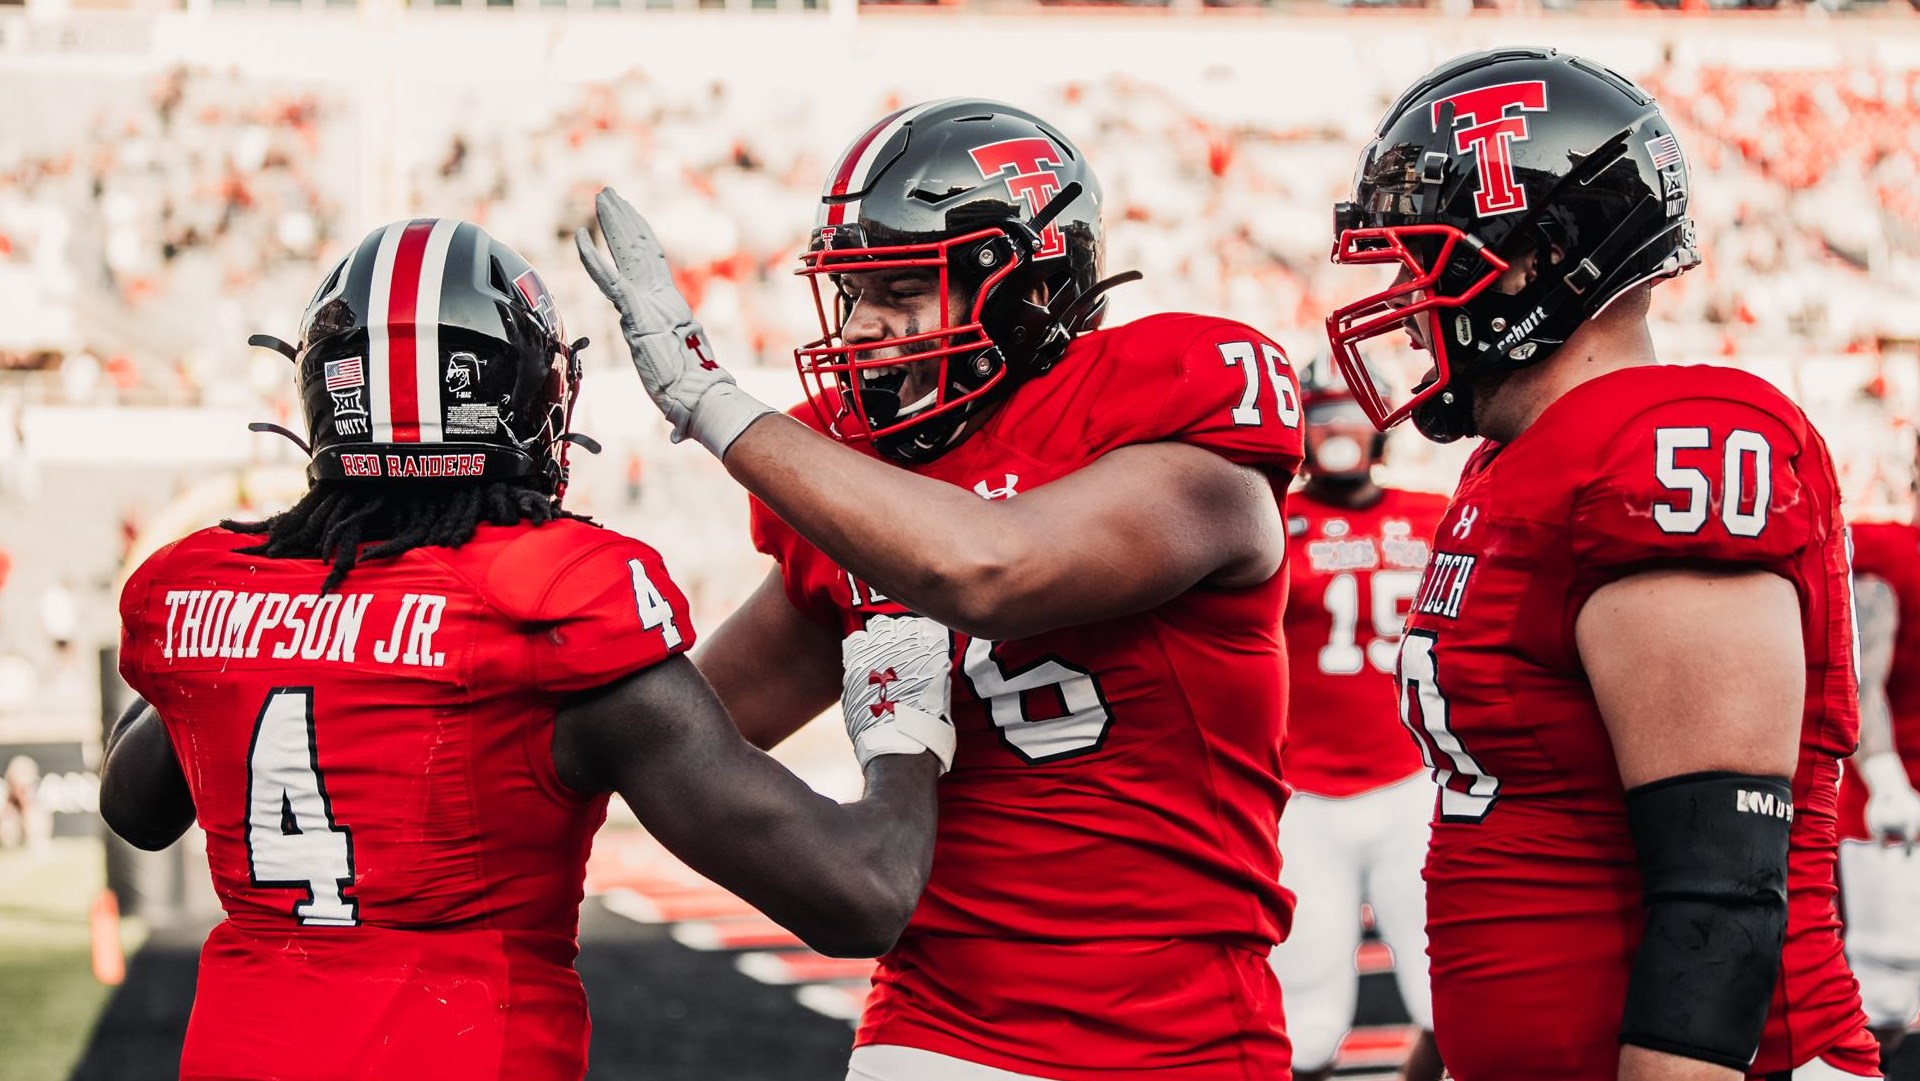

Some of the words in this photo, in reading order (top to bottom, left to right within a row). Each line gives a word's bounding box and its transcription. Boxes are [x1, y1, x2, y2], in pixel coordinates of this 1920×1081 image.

[335, 417, 369, 436] UNITY
[1217, 341, 1302, 430] 76
[341, 453, 382, 476] RED
[386, 453, 486, 477] RAIDERS
[1652, 426, 1772, 538] 50
[163, 590, 373, 663] THOMPSON
[373, 594, 447, 667] JR.
[627, 558, 683, 650] 4
[1318, 571, 1425, 676] 15
[961, 635, 1115, 766] 6
[244, 686, 362, 928] 4
